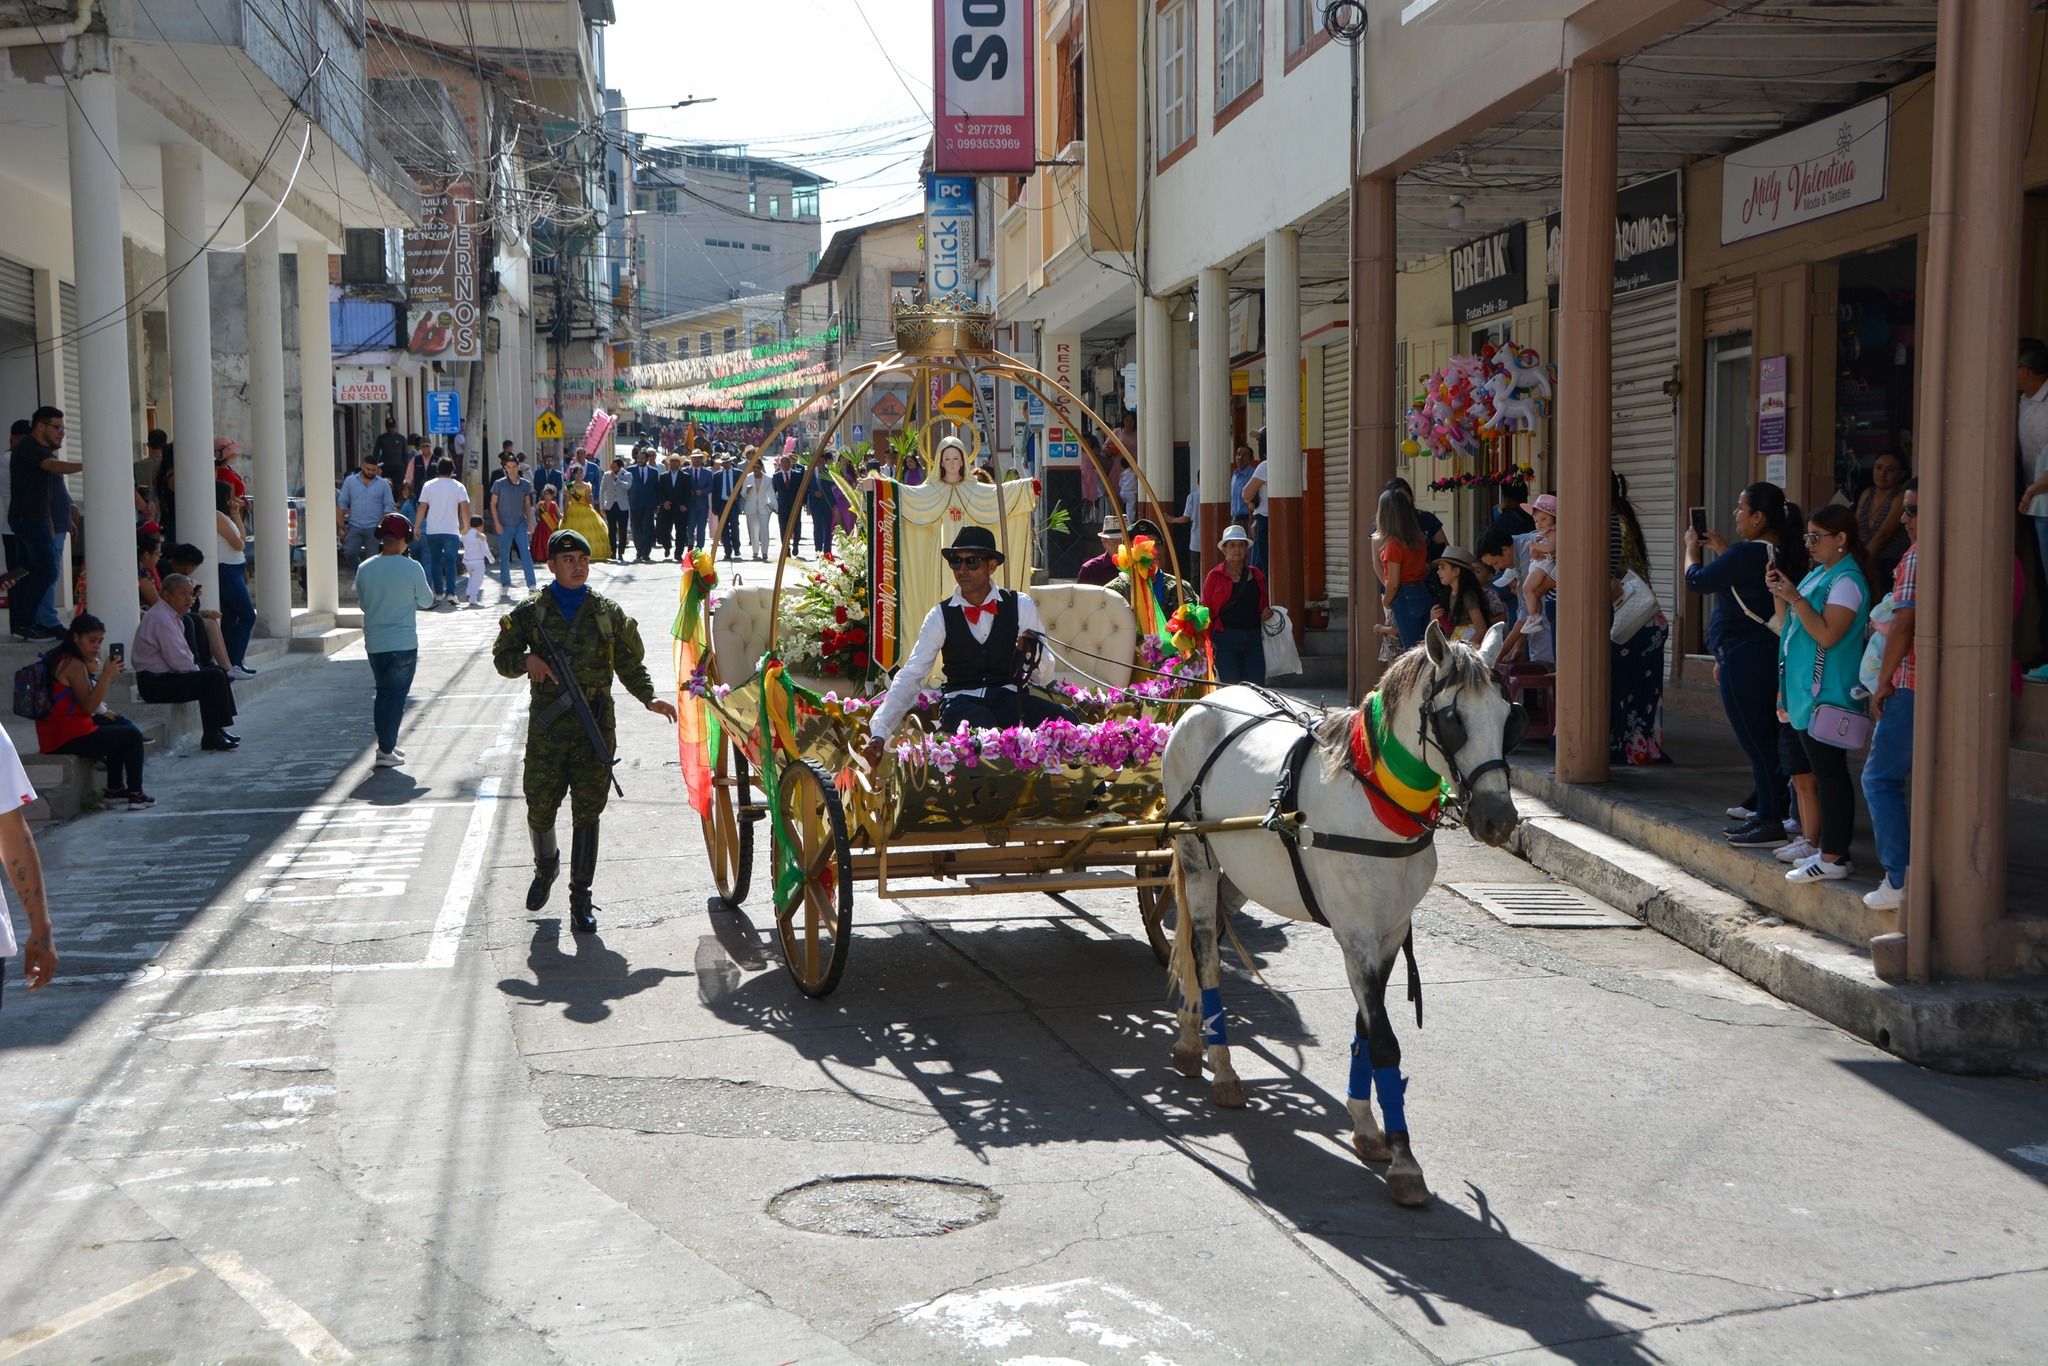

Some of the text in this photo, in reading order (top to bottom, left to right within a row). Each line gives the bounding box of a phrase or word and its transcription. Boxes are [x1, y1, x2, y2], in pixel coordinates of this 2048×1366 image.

[967, 124, 1012, 135] 2977798
[957, 139, 1020, 150] 0993653969
[940, 183, 962, 198] PC
[1742, 157, 1856, 224] Milly Valentina
[1804, 197, 1820, 210] Moda
[1828, 188, 1851, 204] Textiles
[931, 220, 959, 292] Click
[962, 220, 970, 284] SOLUCIONES
[1453, 233, 1510, 292] BREAK
[412, 267, 445, 276] DAMAS
[453, 198, 474, 352] TERNOS
[410, 286, 443, 295] TERNOS
[340, 392, 388, 401] EN SECO
[341, 384, 387, 393] LAVADO
[437, 402, 450, 416] E
[877, 498, 897, 548] Virgen
[882, 549, 897, 569] de
[877, 582, 897, 640] Merced
[245, 807, 434, 903] GARAJE
